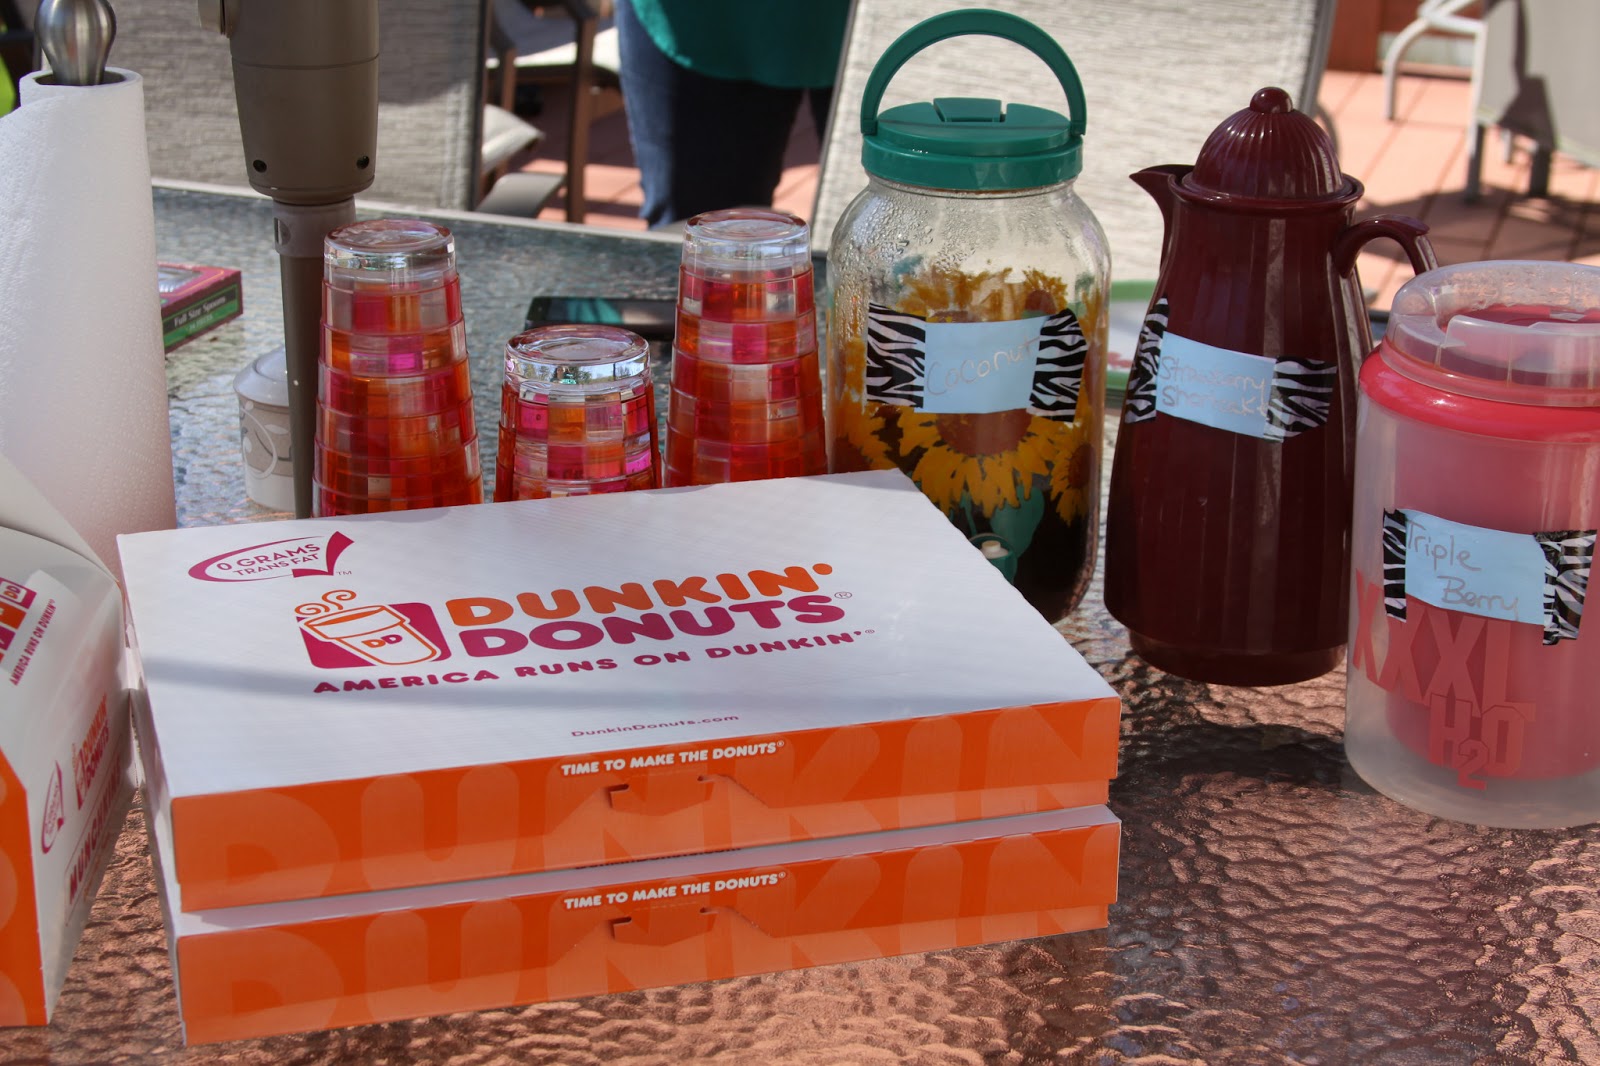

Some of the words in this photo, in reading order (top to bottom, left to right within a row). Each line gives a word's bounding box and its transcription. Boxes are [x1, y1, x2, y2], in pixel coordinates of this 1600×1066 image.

[236, 543, 320, 568] GRAMS
[1406, 519, 1482, 572] Triple
[233, 559, 290, 577] TRANS
[290, 553, 320, 566] FAT
[1437, 575, 1519, 621] Berry
[361, 633, 403, 648] DD
[458, 595, 845, 657] DONUTS
[1352, 568, 1537, 722] XXXL
[313, 669, 500, 693] AMERICA
[514, 658, 618, 677] RUNS
[633, 651, 691, 666] ON
[571, 715, 740, 737] DunkinDonuts.com
[1428, 693, 1527, 790] H2O
[561, 761, 599, 776] TIME
[603, 758, 626, 772] TO
[630, 753, 675, 769] MAKE
[679, 748, 708, 763] THE
[564, 894, 602, 910] TIME
[606, 891, 628, 904] TO
[632, 885, 677, 901] MAKE
[681, 881, 710, 895] THE
